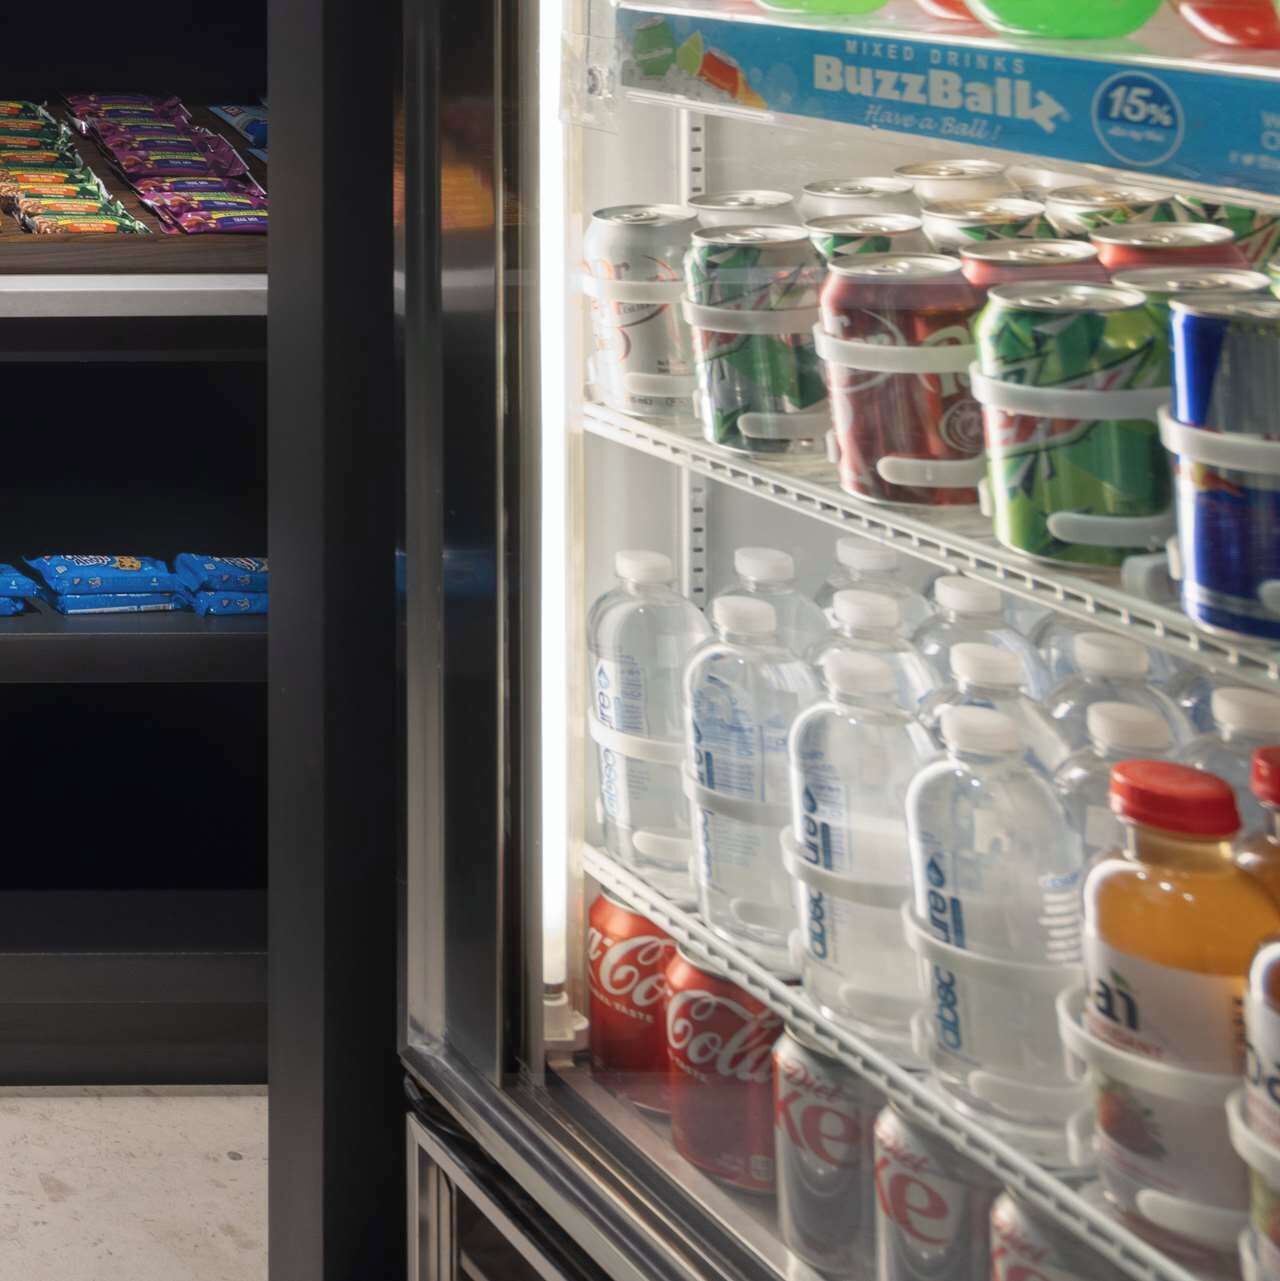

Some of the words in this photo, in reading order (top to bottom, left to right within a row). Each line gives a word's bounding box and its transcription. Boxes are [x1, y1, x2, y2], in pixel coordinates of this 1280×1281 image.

[845, 39, 915, 63] MIXED
[930, 47, 1026, 76] DRINKS
[812, 53, 1069, 133] BuzzBallz
[1108, 84, 1174, 127] 15%
[863, 103, 914, 131] Have
[916, 117, 938, 130] a
